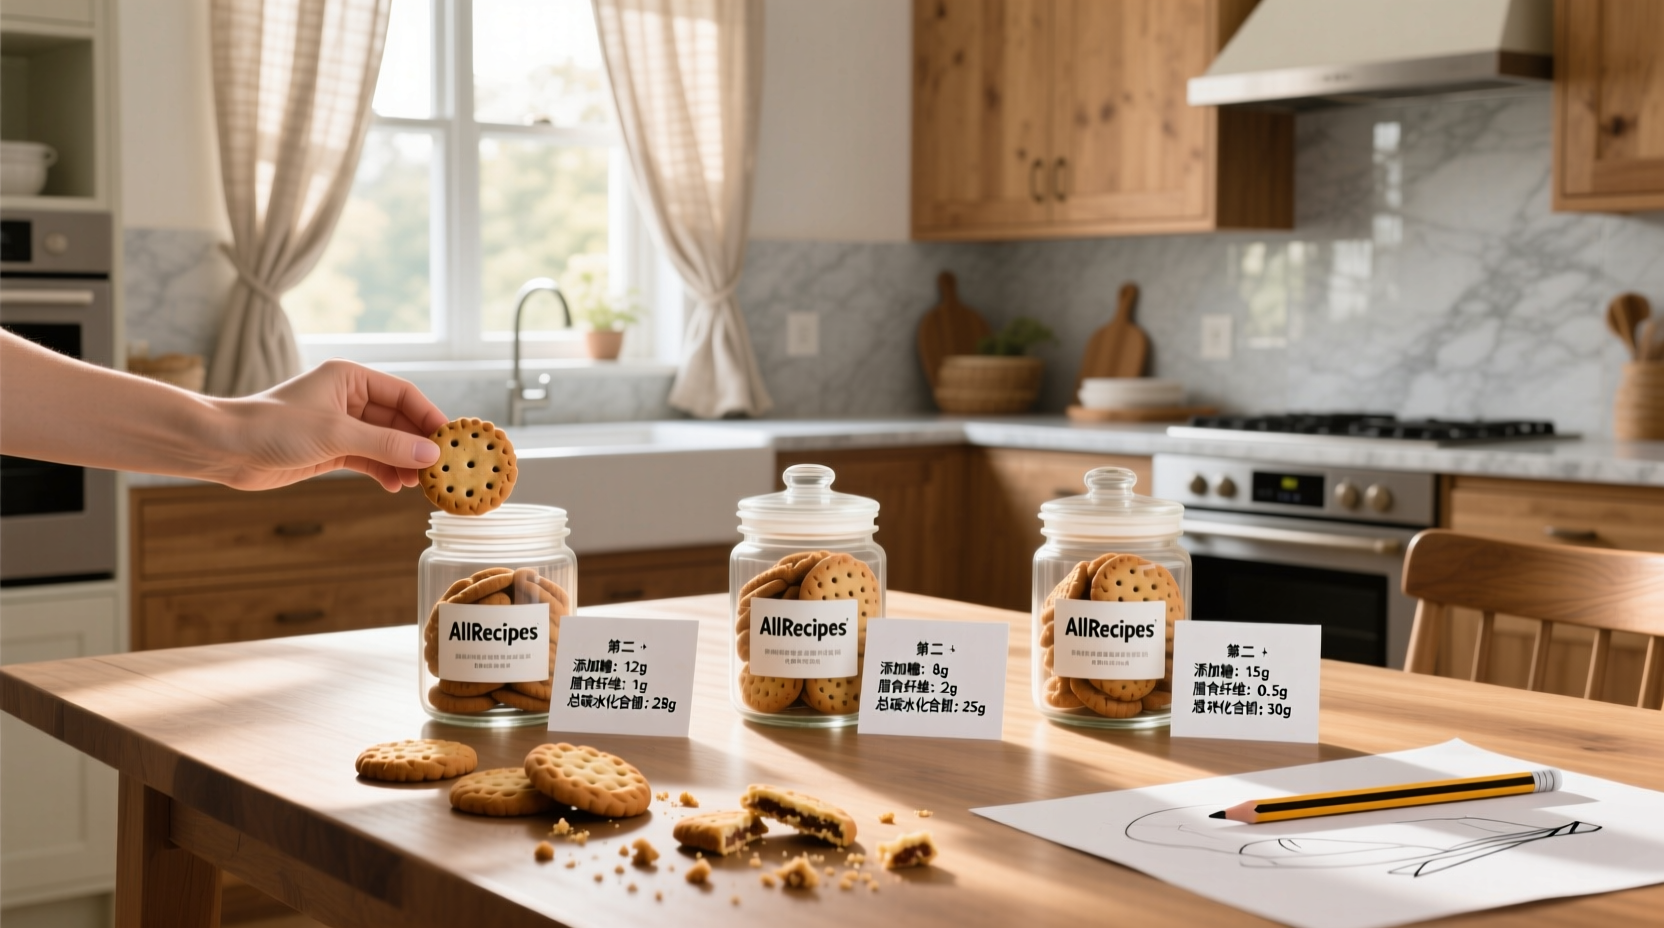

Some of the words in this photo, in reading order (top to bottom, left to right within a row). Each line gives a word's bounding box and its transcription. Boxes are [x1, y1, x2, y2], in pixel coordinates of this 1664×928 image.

[624, 660, 647, 676] 12g
[932, 663, 949, 678] 8g
[1246, 665, 1270, 681] 15g
[632, 679, 647, 693] 1g
[940, 681, 957, 696] 2g
[1257, 683, 1287, 700] 0.5g
[962, 700, 986, 716] 25g
[1267, 703, 1292, 719] 30g
